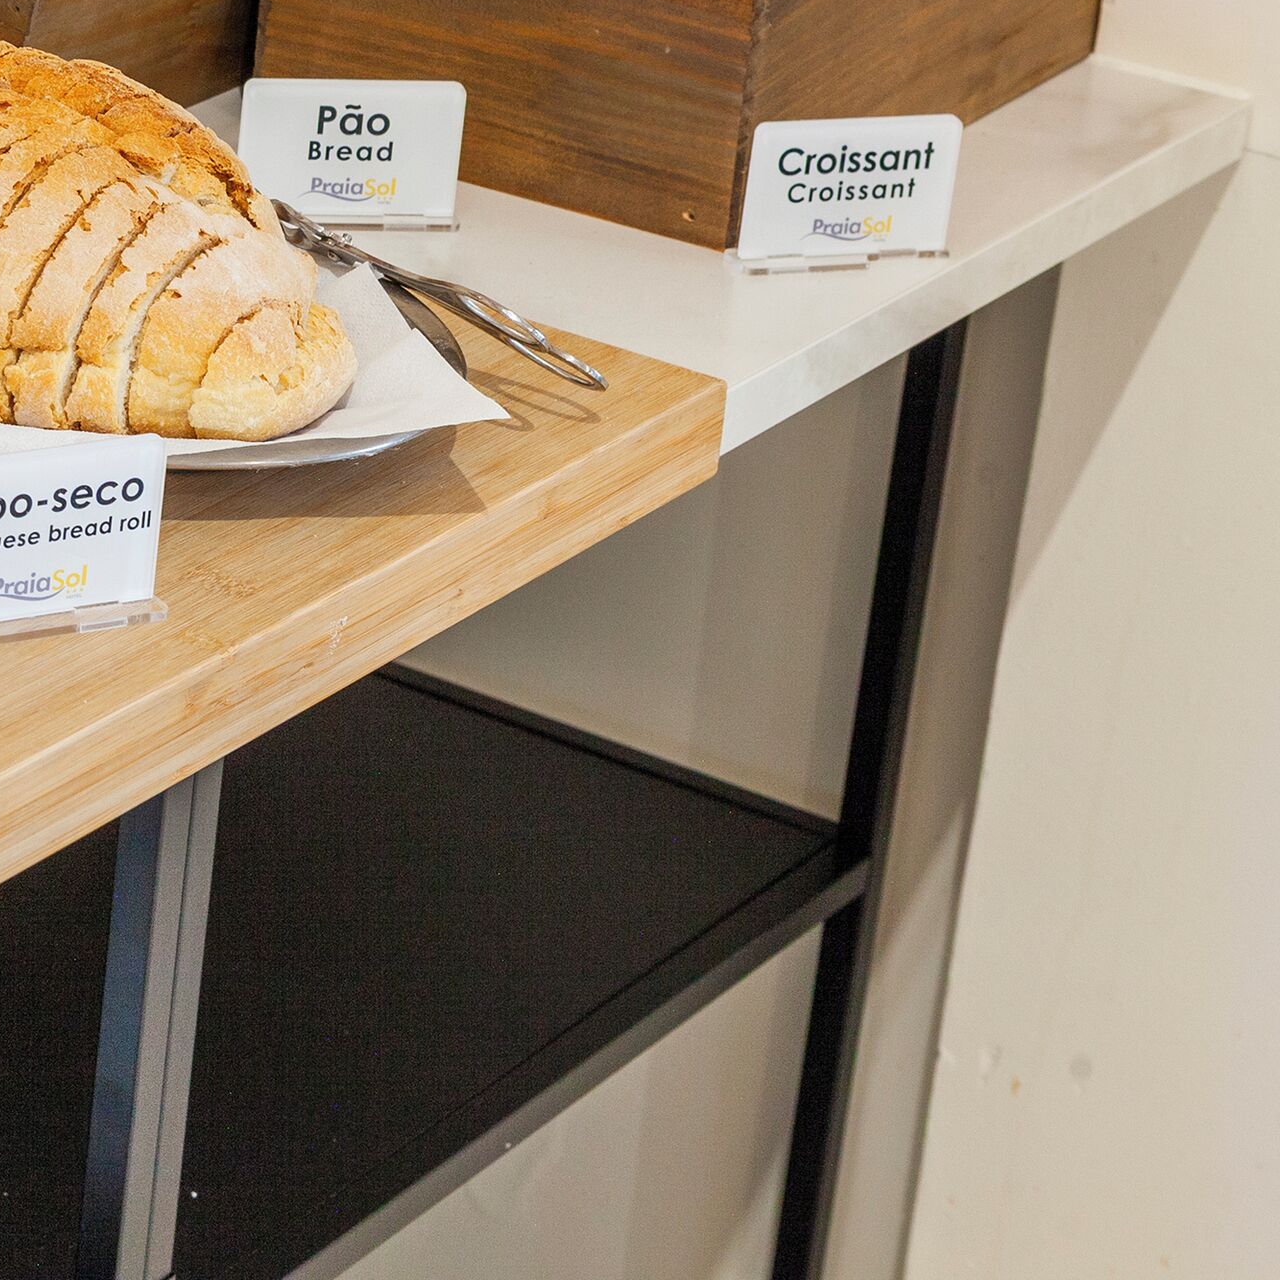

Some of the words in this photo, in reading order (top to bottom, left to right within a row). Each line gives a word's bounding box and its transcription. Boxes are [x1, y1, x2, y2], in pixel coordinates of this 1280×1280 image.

[316, 104, 391, 136] Pão
[308, 141, 393, 161] Bread
[778, 141, 935, 176] Croissant
[311, 176, 397, 195] PraiaSol
[788, 178, 915, 203] Croissant
[812, 215, 893, 235] PraiaSol
[48, 516, 113, 543] bread
[119, 510, 152, 532] roll
